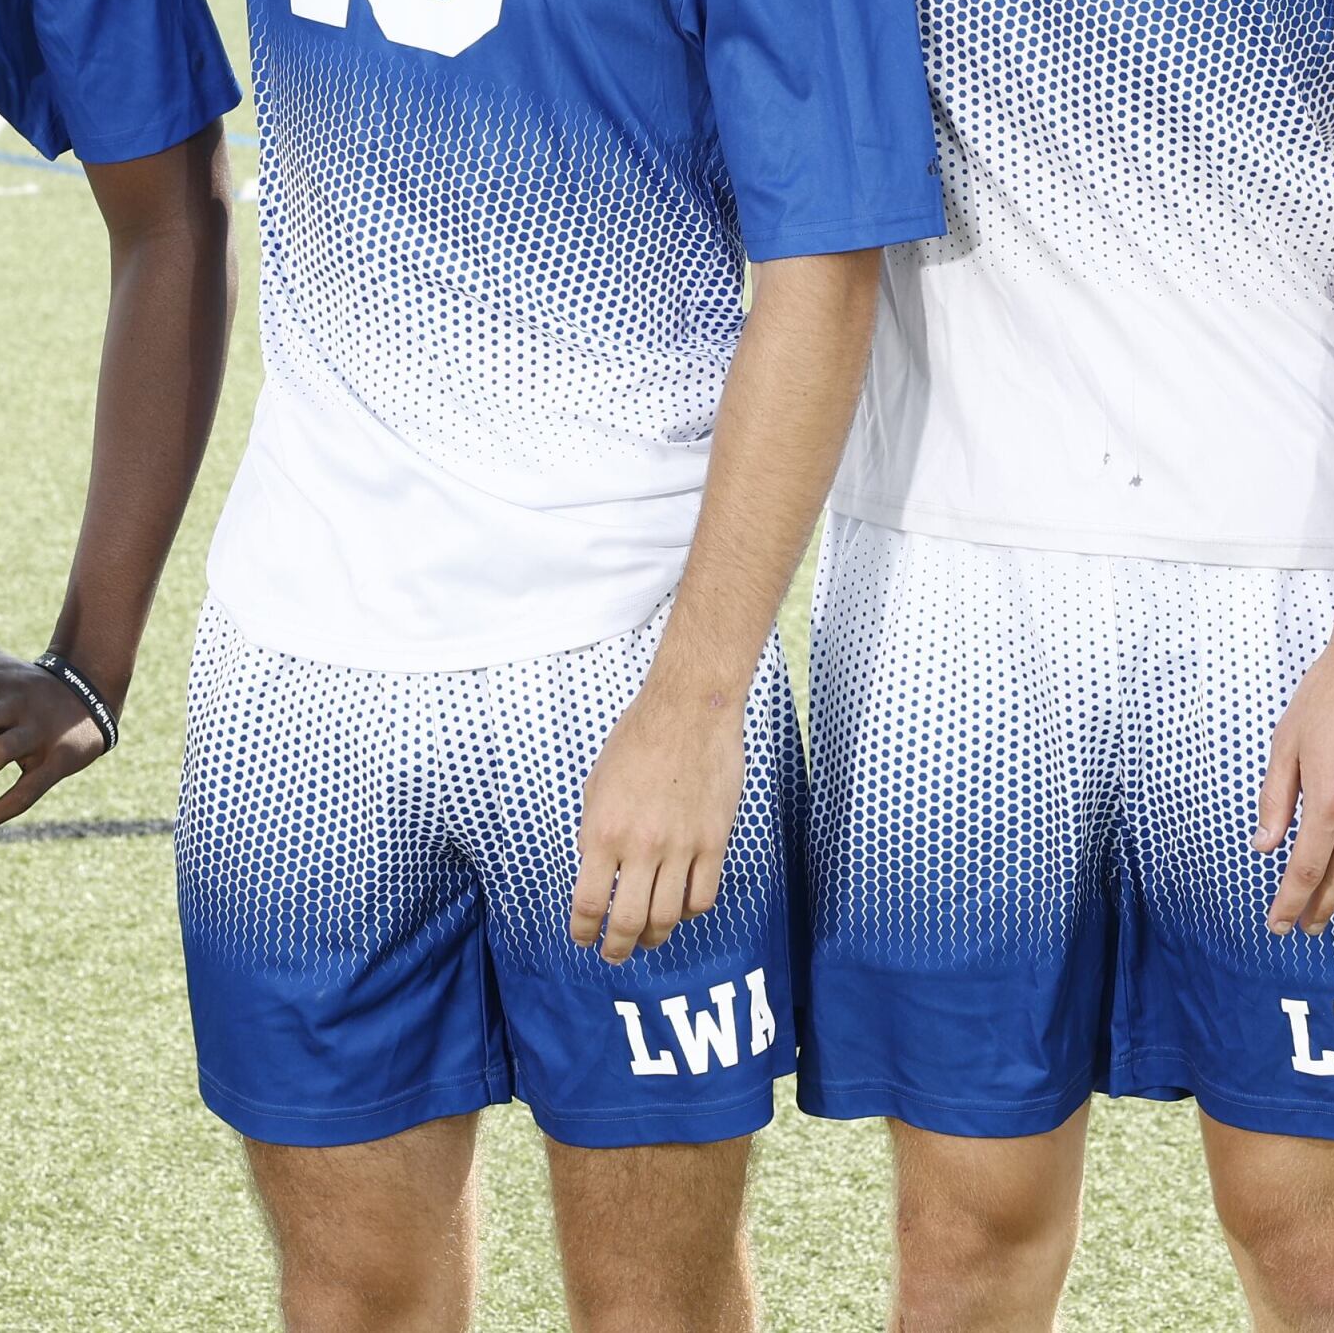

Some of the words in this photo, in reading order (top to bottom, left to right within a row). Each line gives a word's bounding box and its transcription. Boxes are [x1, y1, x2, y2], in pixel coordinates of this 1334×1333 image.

[64, 667, 91, 696] trouble.
[88, 693, 98, 705] in
[95, 702, 110, 724] help
[614, 967, 776, 1075] LWA
